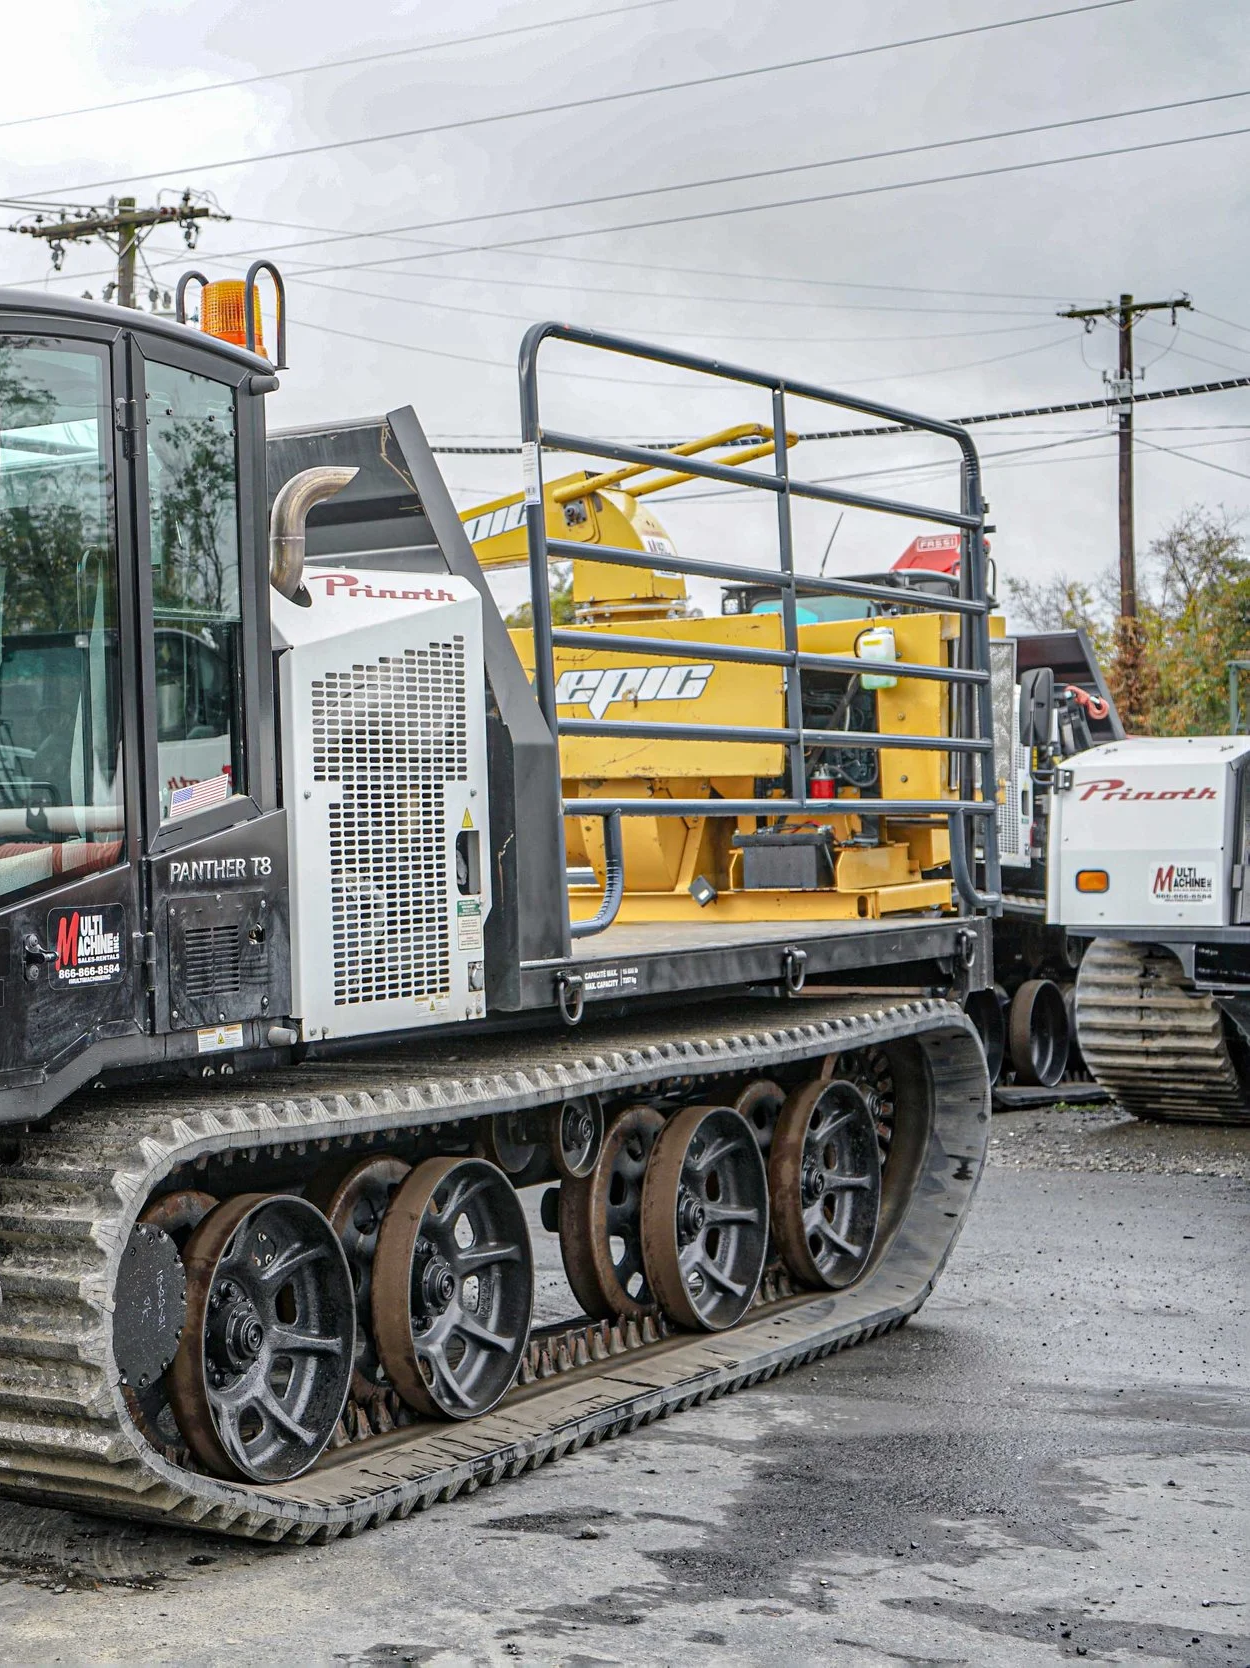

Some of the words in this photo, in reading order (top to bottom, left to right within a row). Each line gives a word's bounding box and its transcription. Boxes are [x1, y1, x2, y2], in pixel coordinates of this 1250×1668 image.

[919, 538, 955, 549] FASSI
[309, 574, 457, 602] Prinoth
[555, 664, 715, 719] epic
[1075, 779, 1217, 801] Prinoth
[170, 858, 246, 882] PANTHER
[251, 857, 272, 876] T8
[59, 963, 120, 979] 866-866-8584
